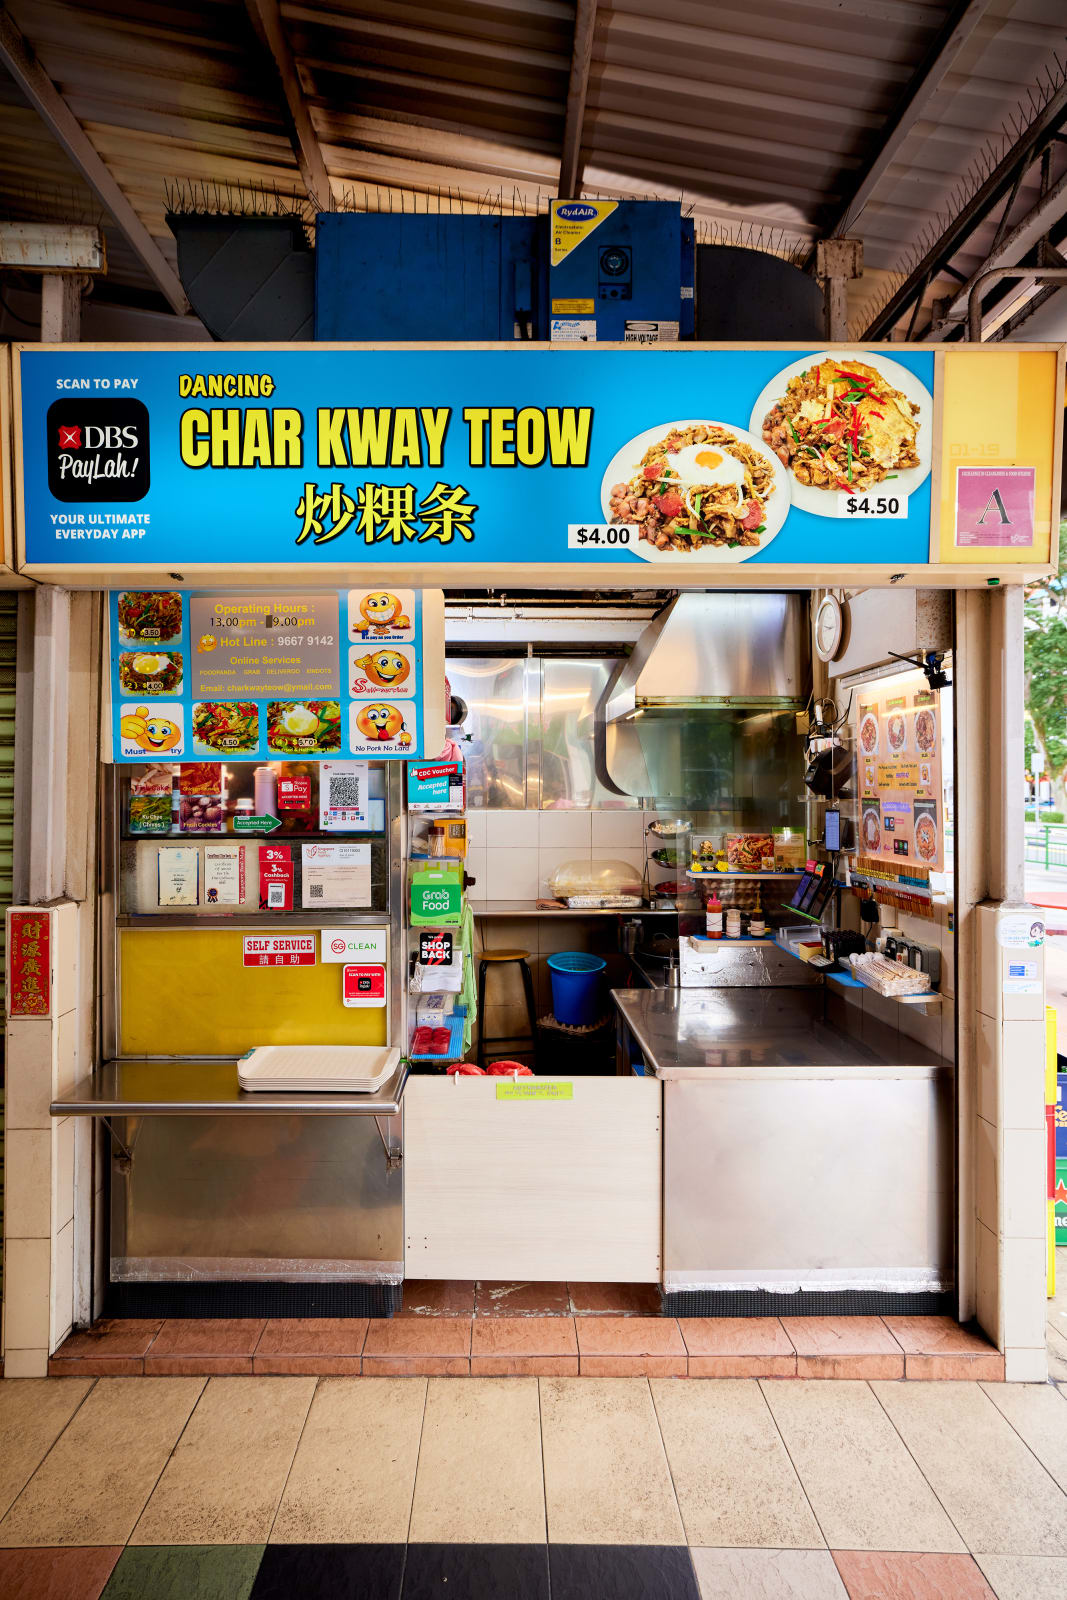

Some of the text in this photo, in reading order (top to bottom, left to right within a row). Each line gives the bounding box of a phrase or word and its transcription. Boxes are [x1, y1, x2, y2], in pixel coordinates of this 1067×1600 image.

[56, 378, 139, 389] SCAN TO PAY
[179, 374, 275, 397] DANCING
[84, 426, 139, 448] DBS
[180, 407, 594, 468] CHAR KWAY TEOW
[59, 453, 139, 484] PayLah!
[846, 497, 899, 516] $4.50
[976, 487, 1014, 525] A
[295, 482, 479, 544] 炒粿条
[50, 514, 151, 525] YOUR ULTIMATE
[55, 529, 146, 540] EVERYDAY APP
[576, 527, 630, 545] $4.00
[214, 603, 271, 616] Operating
[273, 602, 308, 613] Hours
[220, 637, 240, 647] Hot
[243, 637, 267, 647] Line
[277, 636, 304, 646] 9667
[307, 635, 334, 646] 9142
[230, 655, 301, 665] Online Services
[200, 684, 225, 692] Email:
[171, 748, 182, 756] try
[294, 785, 307, 793] Pay
[418, 781, 447, 790] Accepted
[266, 849, 283, 860] 3%
[422, 890, 449, 900] Grab
[422, 901, 449, 910] Food
[247, 940, 312, 951] SELF SERVICE
[422, 942, 450, 950] SHOP
[422, 951, 450, 959] BACK
